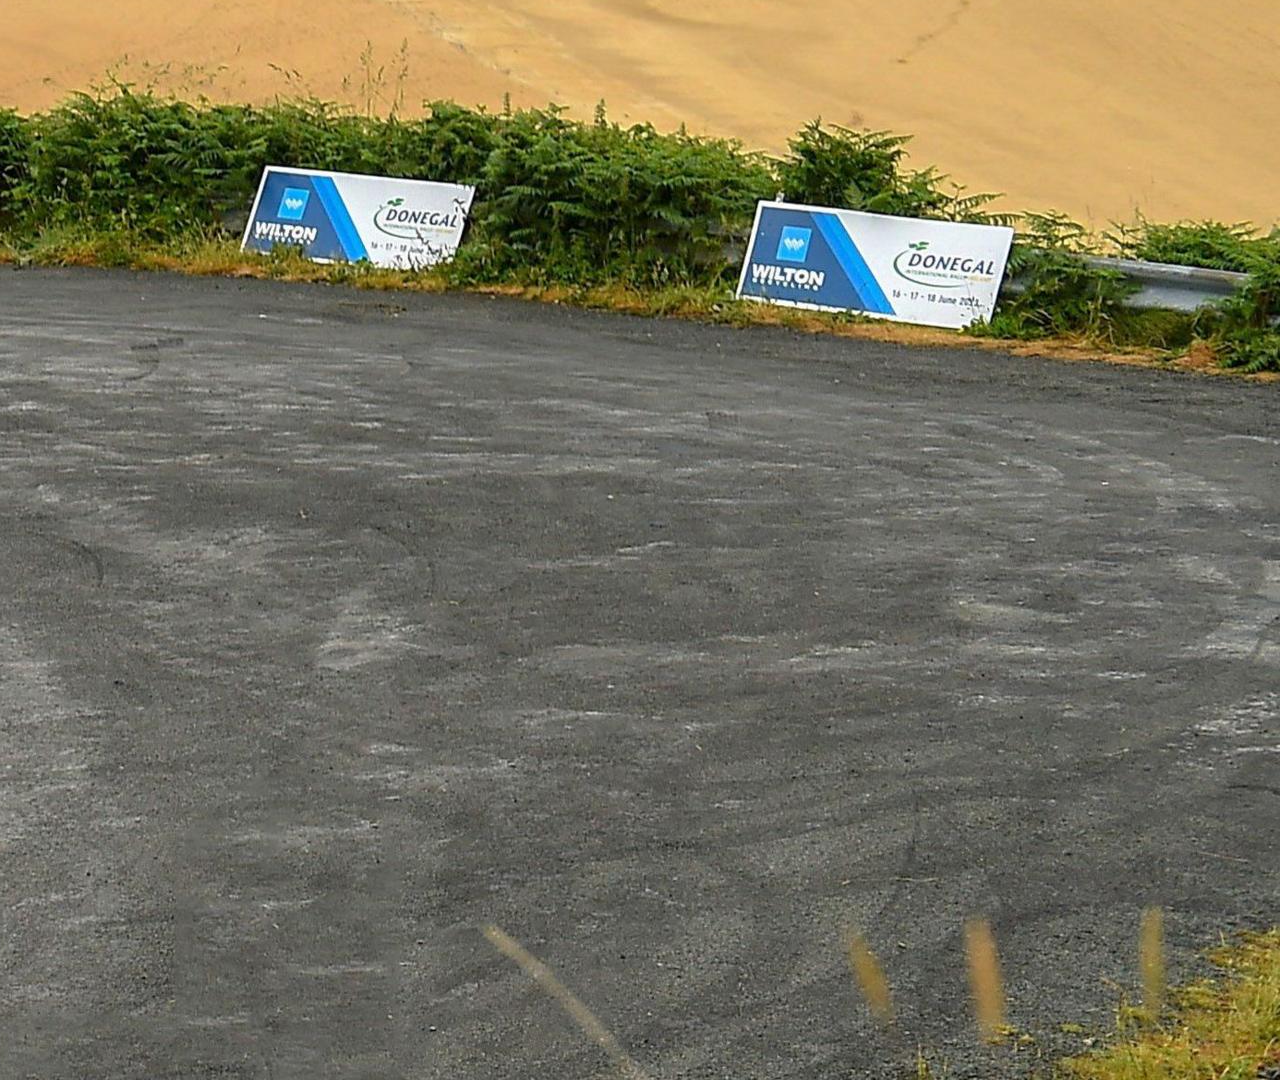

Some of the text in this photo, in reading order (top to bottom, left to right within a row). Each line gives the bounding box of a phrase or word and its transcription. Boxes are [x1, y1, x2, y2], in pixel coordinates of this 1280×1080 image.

[385, 209, 458, 228] DONEGAL
[255, 221, 317, 241] WILTON
[908, 253, 994, 275] DONEGAL
[751, 263, 825, 287] WILTON
[938, 294, 956, 305] June
